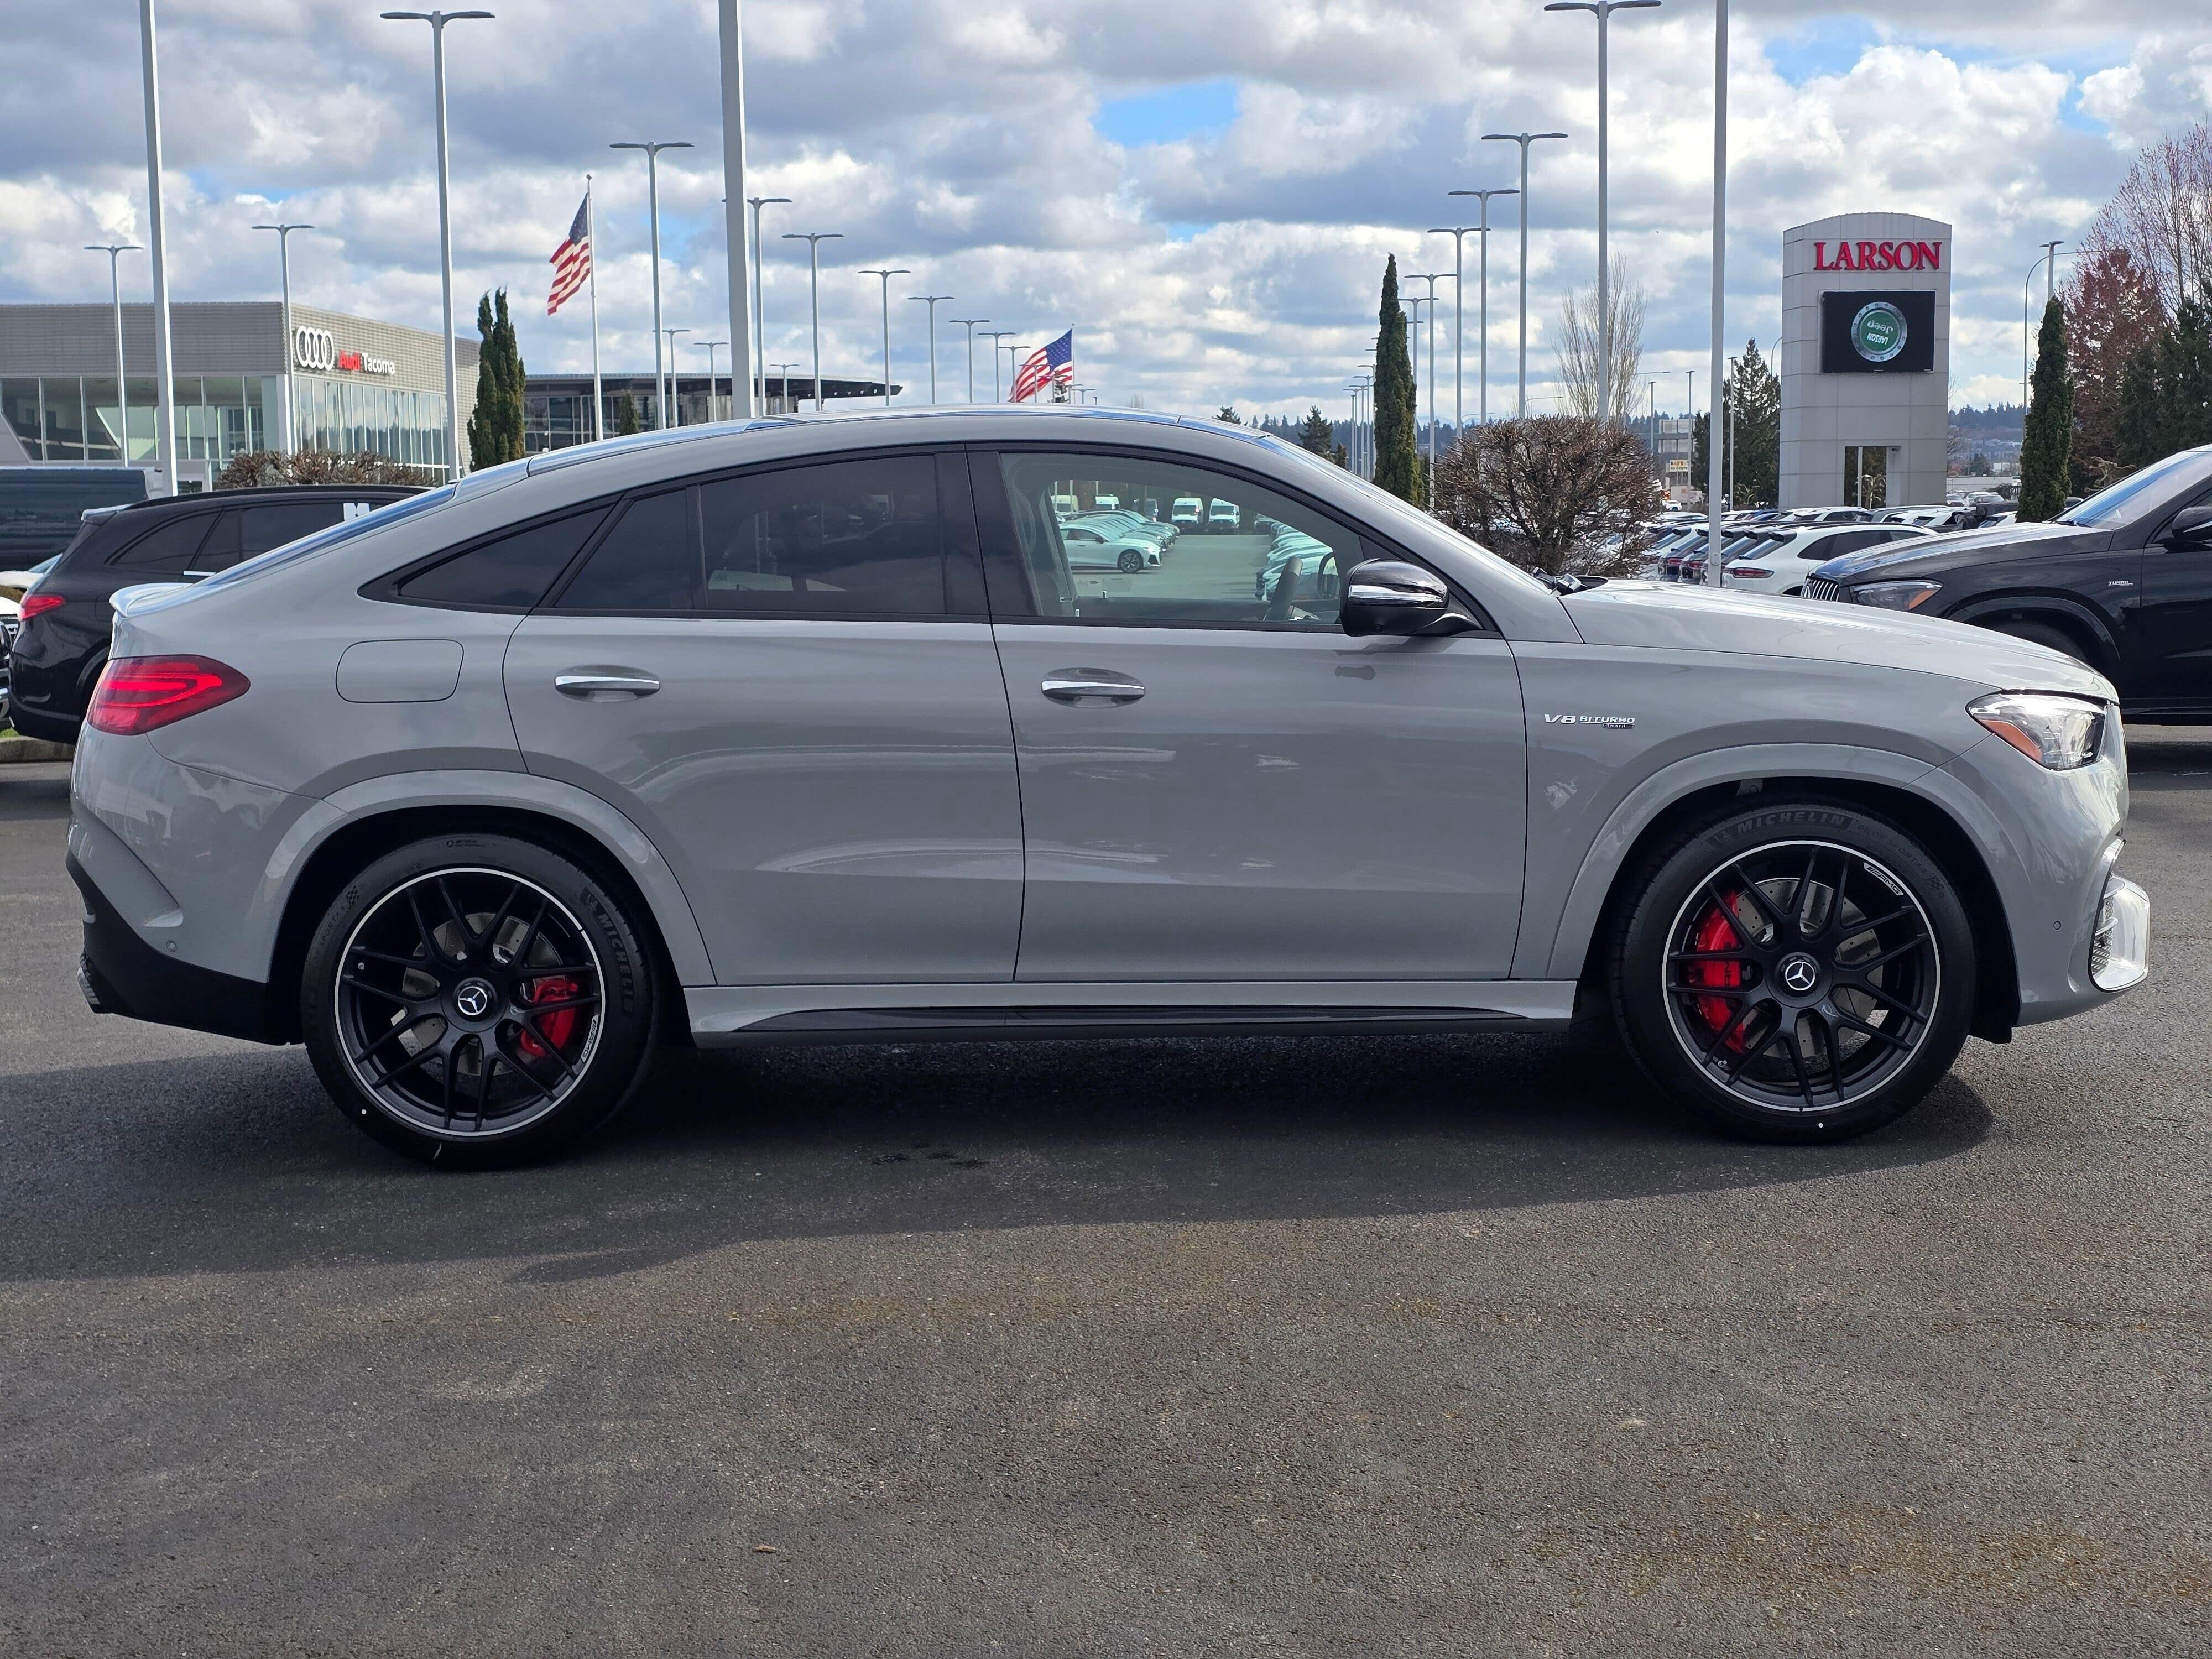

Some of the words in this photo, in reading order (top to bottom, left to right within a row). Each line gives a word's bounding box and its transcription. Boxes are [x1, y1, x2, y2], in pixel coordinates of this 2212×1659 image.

[1813, 241, 1943, 271] LARSON
[1867, 320, 1894, 334] Jeep
[338, 349, 361, 371] Audi
[361, 352, 395, 375] Tacoma
[1544, 714, 1576, 724] V8
[1579, 716, 1635, 724] BITURBO
[1738, 811, 1845, 833] MICHELIN
